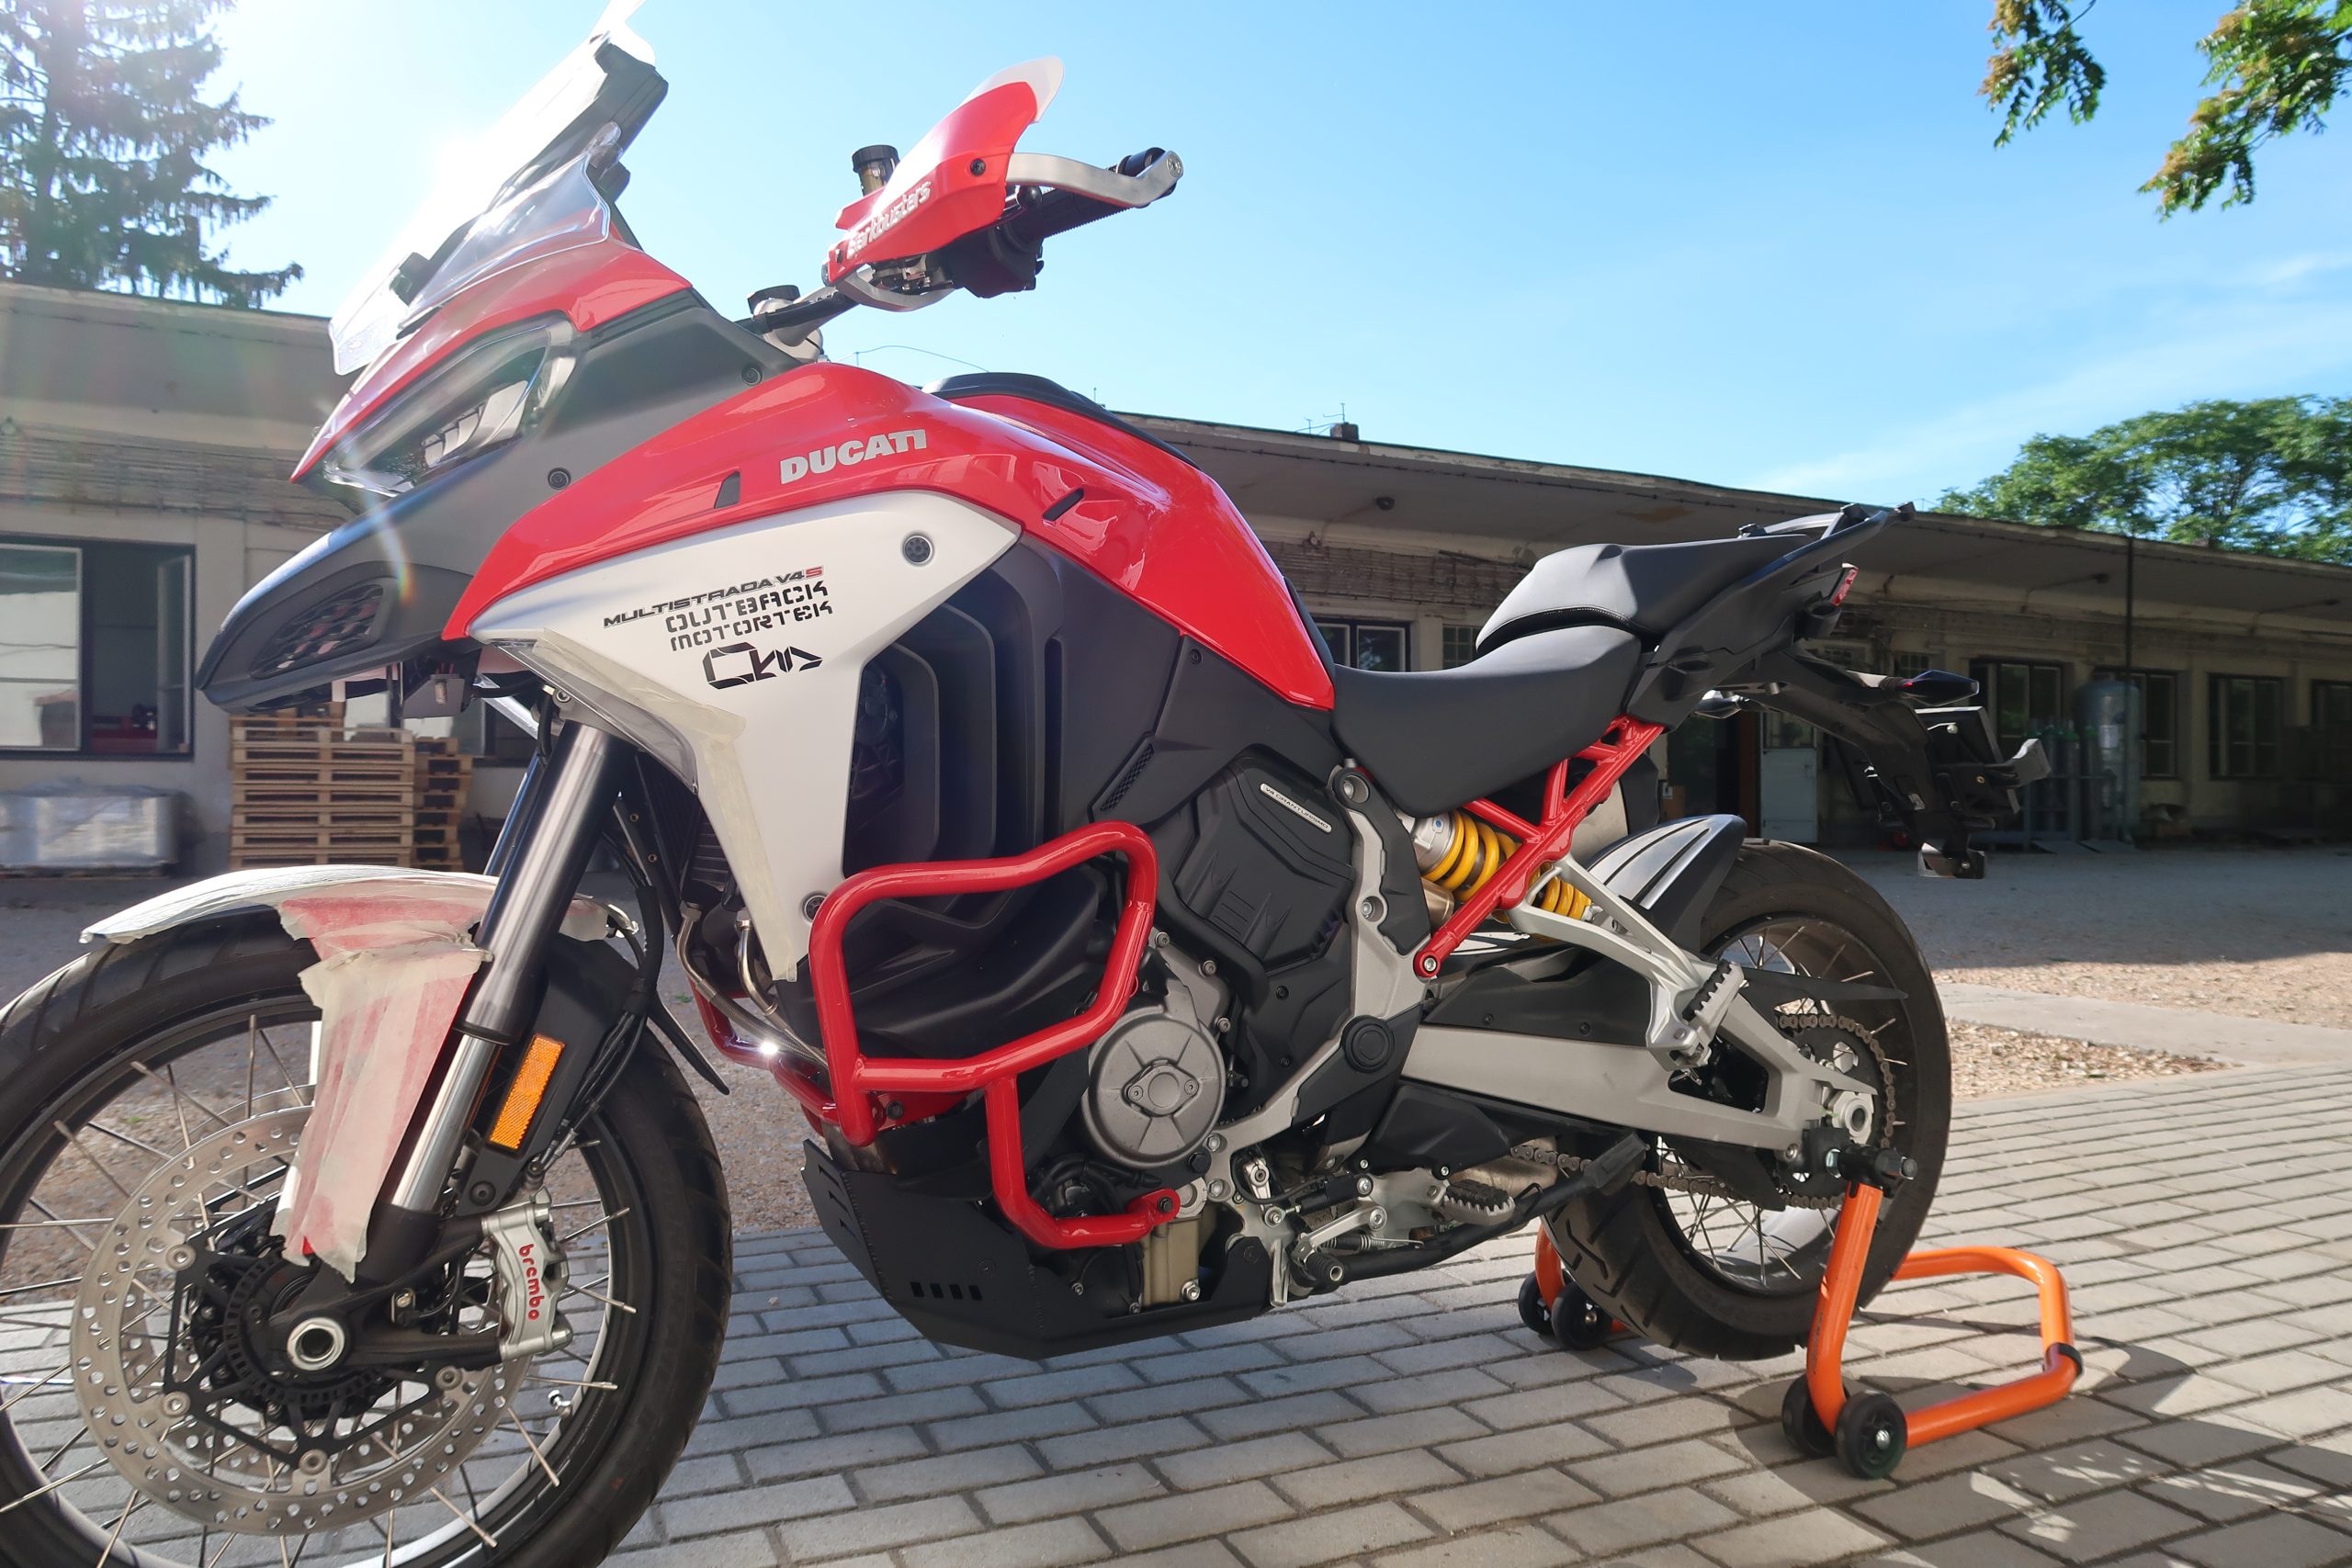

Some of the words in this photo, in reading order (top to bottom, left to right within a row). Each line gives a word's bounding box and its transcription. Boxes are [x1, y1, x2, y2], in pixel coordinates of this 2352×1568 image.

[780, 429, 927, 484] DUCATI
[603, 578, 774, 628] MULTISTRADA
[665, 581, 829, 633] OUTBACK
[670, 601, 833, 651] MOTORTEK
[519, 1243, 545, 1321] brembo
